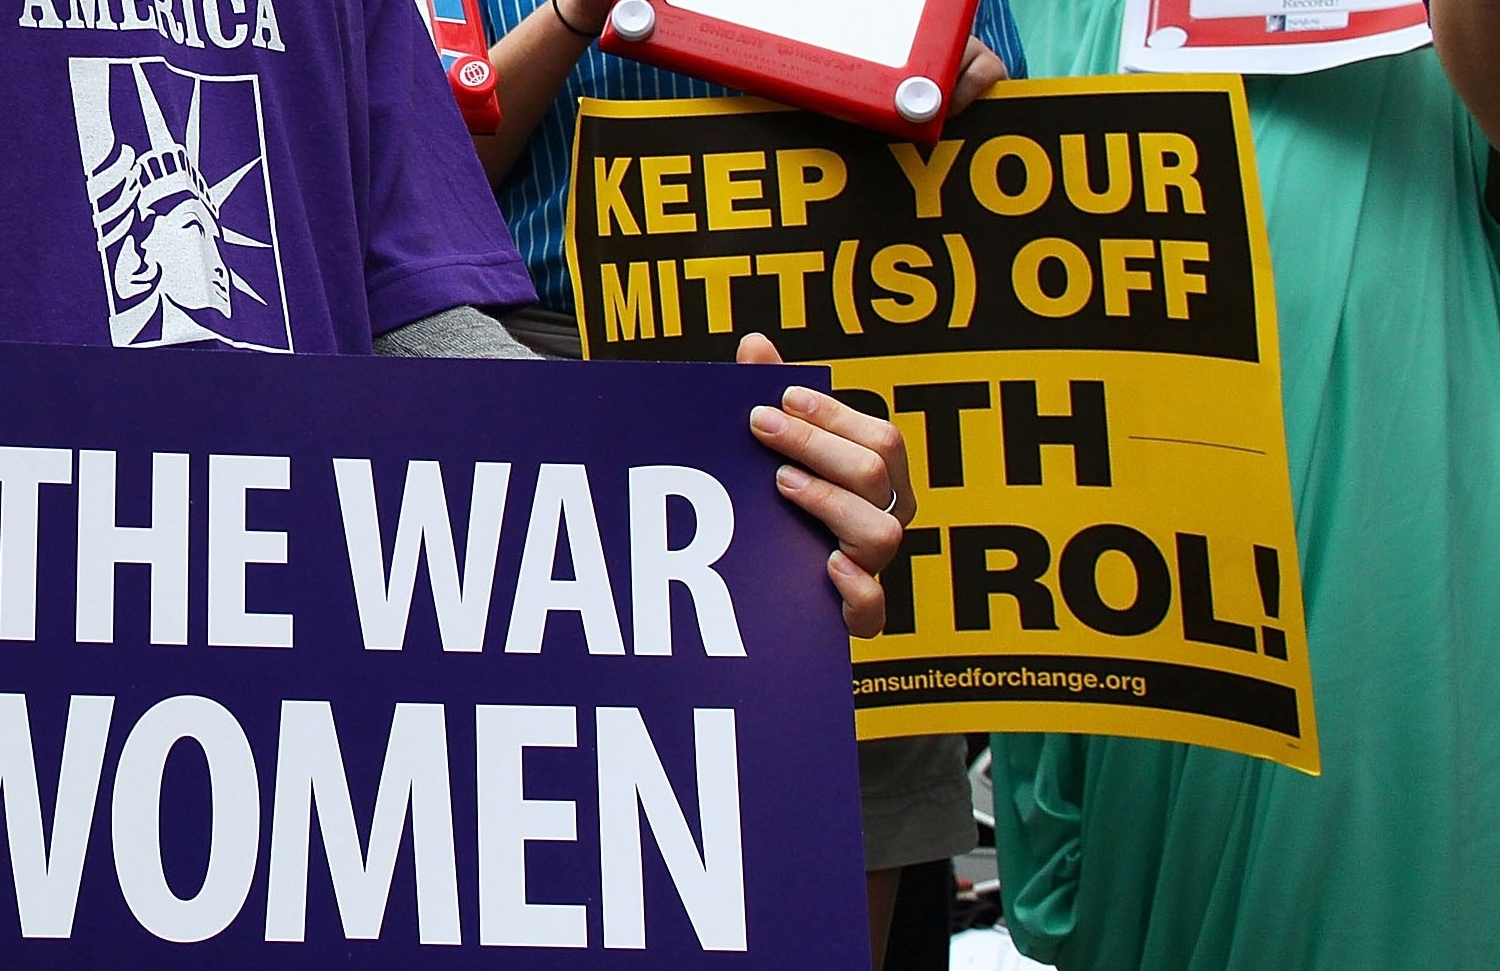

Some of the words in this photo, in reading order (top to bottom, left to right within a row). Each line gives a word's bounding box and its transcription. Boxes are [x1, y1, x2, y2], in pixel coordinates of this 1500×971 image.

[594, 147, 848, 237] KEEP
[887, 132, 1206, 219] YOUR
[600, 234, 978, 344] MITT(S)
[1011, 237, 1210, 320] OFF
[333, 458, 747, 658] WAR
